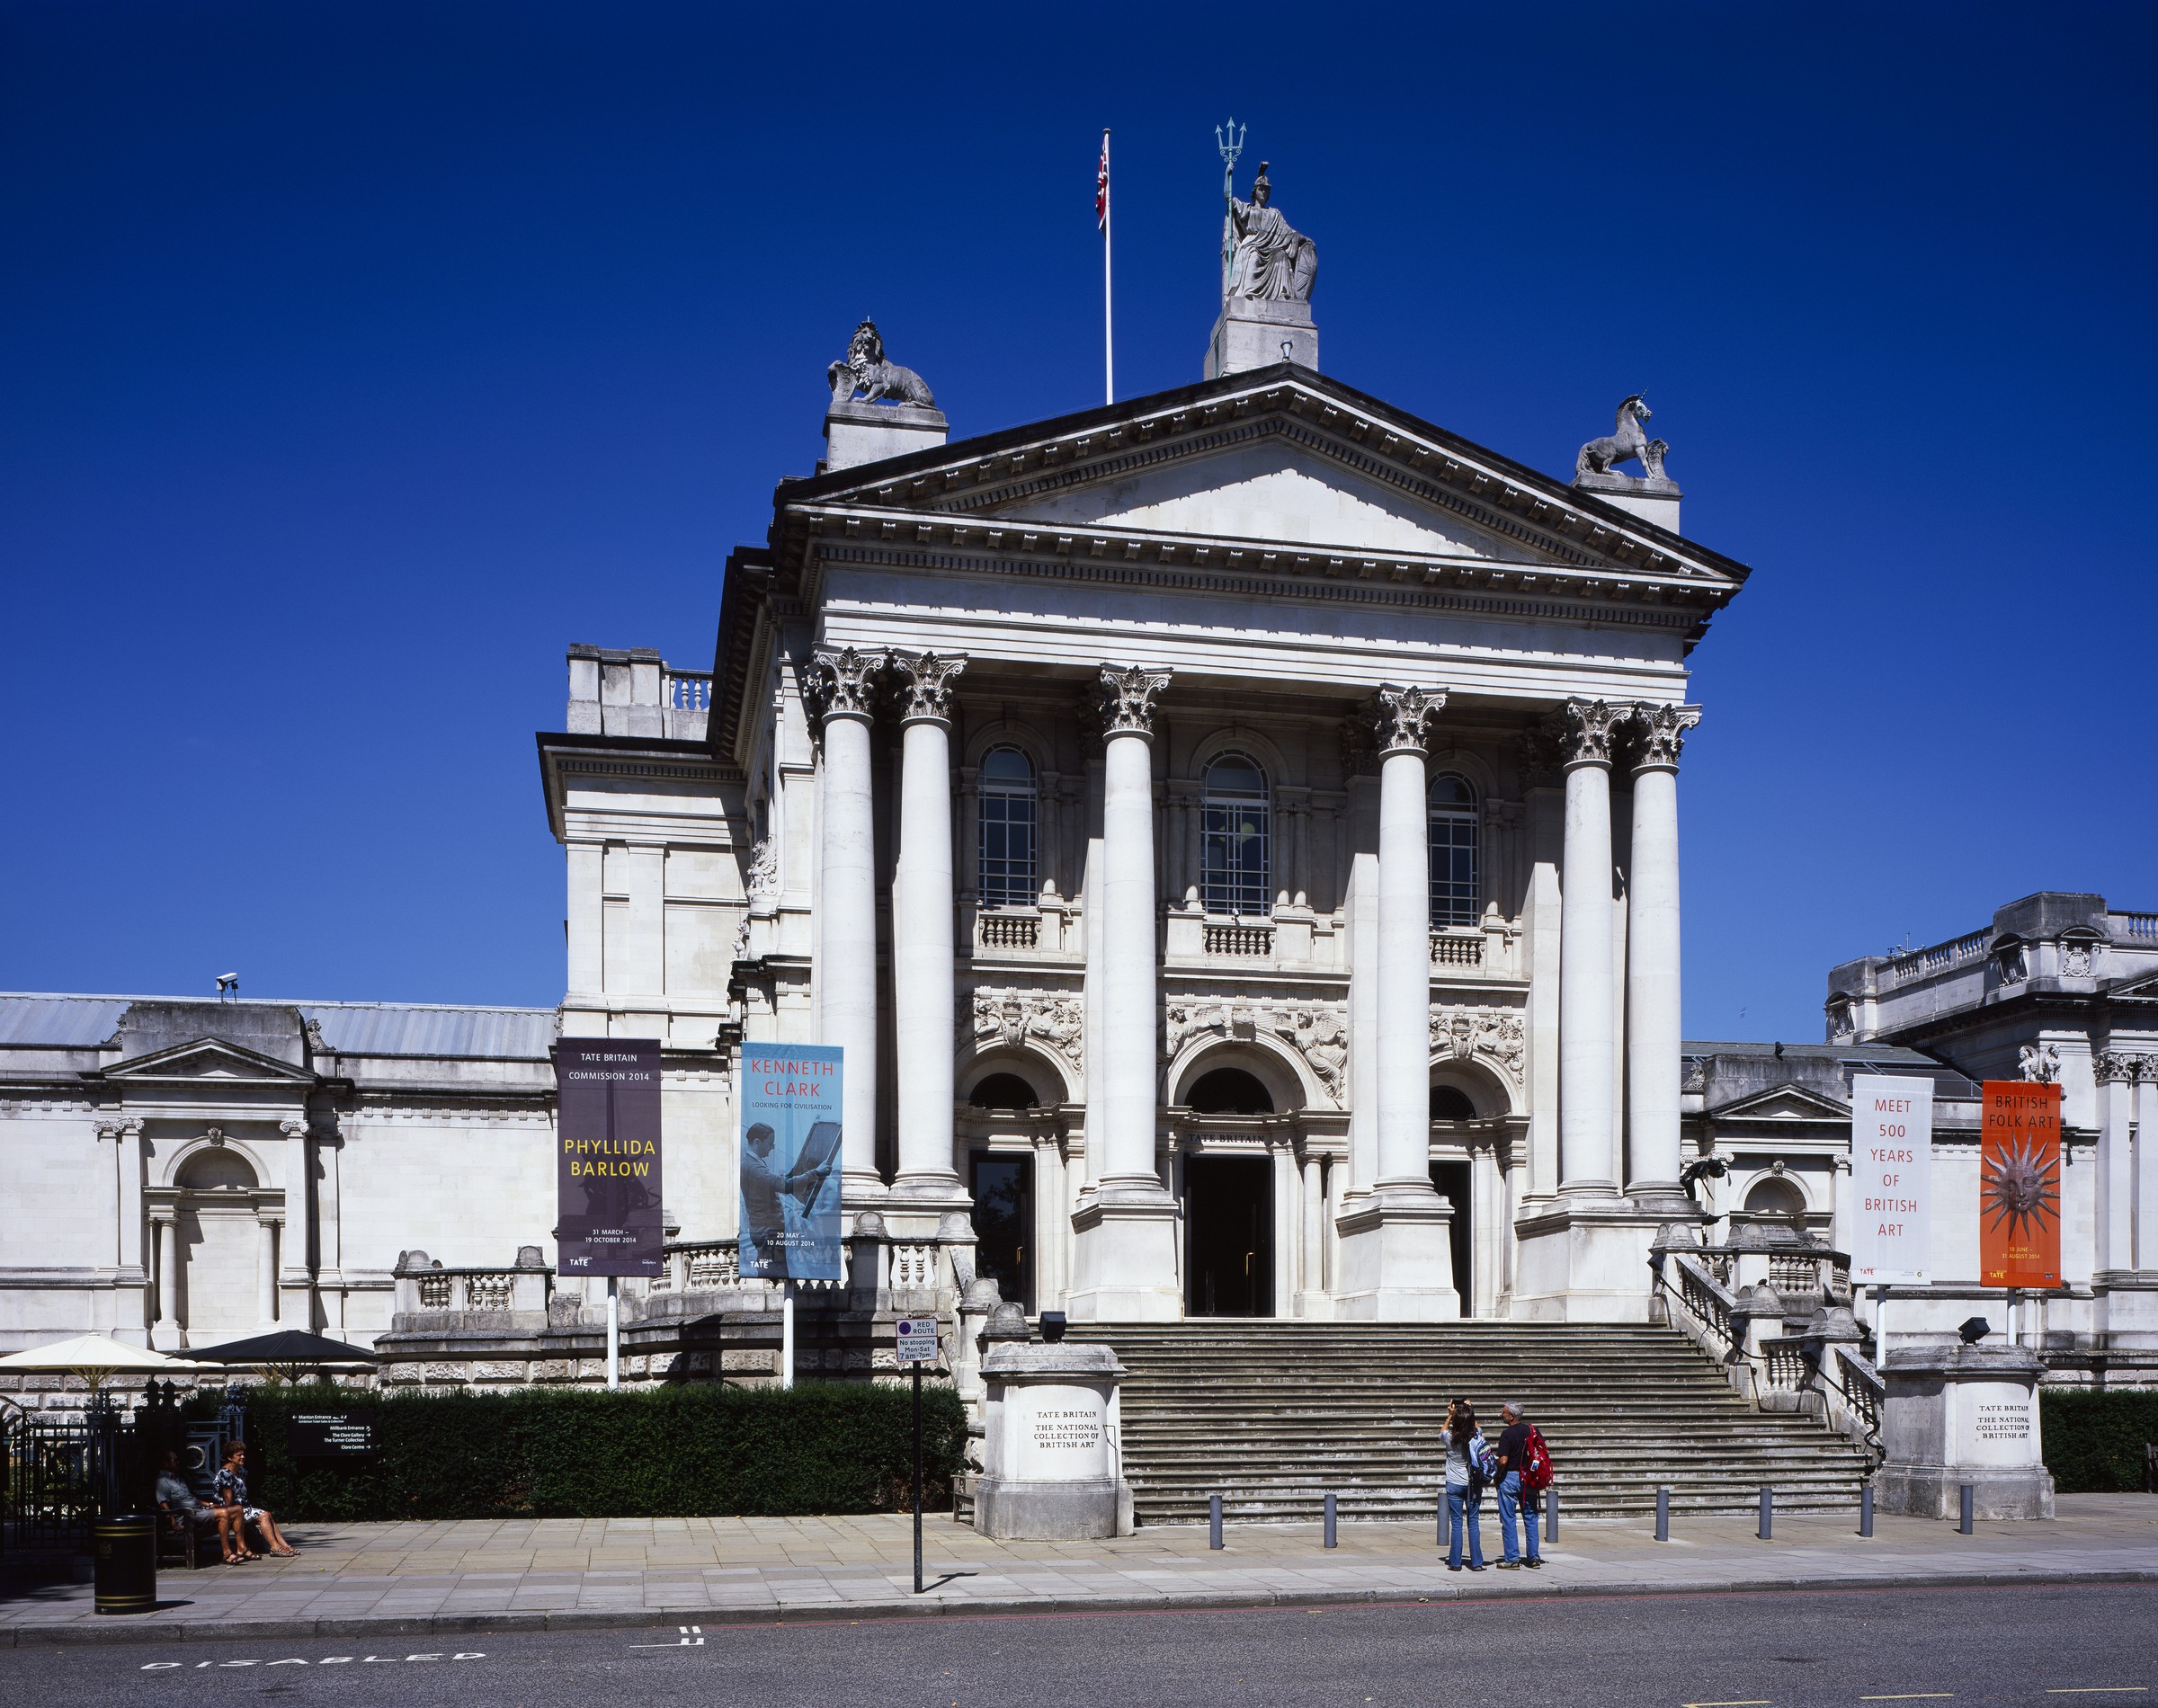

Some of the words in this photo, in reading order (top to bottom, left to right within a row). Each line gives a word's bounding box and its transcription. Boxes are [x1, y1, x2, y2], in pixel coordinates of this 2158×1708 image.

[752, 1059, 833, 1076] KENNETH
[569, 1072, 625, 1080] COMMISSION
[765, 1081, 820, 1097] CLARK
[1875, 1099, 1911, 1113] MEET
[1996, 1095, 2047, 1109] BRITISH
[1989, 1114, 2022, 1127] FOLK
[2028, 1116, 2054, 1128] ART
[1880, 1124, 1905, 1137] 500
[1220, 1135, 1264, 1143] BRITAIN
[565, 1139, 655, 1155] PHYLLIDA
[1870, 1149, 1913, 1163] YEARS
[571, 1161, 649, 1176] BARLOW
[1883, 1174, 1899, 1187] OF
[1865, 1198, 1917, 1212] BRITISH
[1878, 1223, 1903, 1236] ART
[140, 1652, 486, 1669] DISABLED
